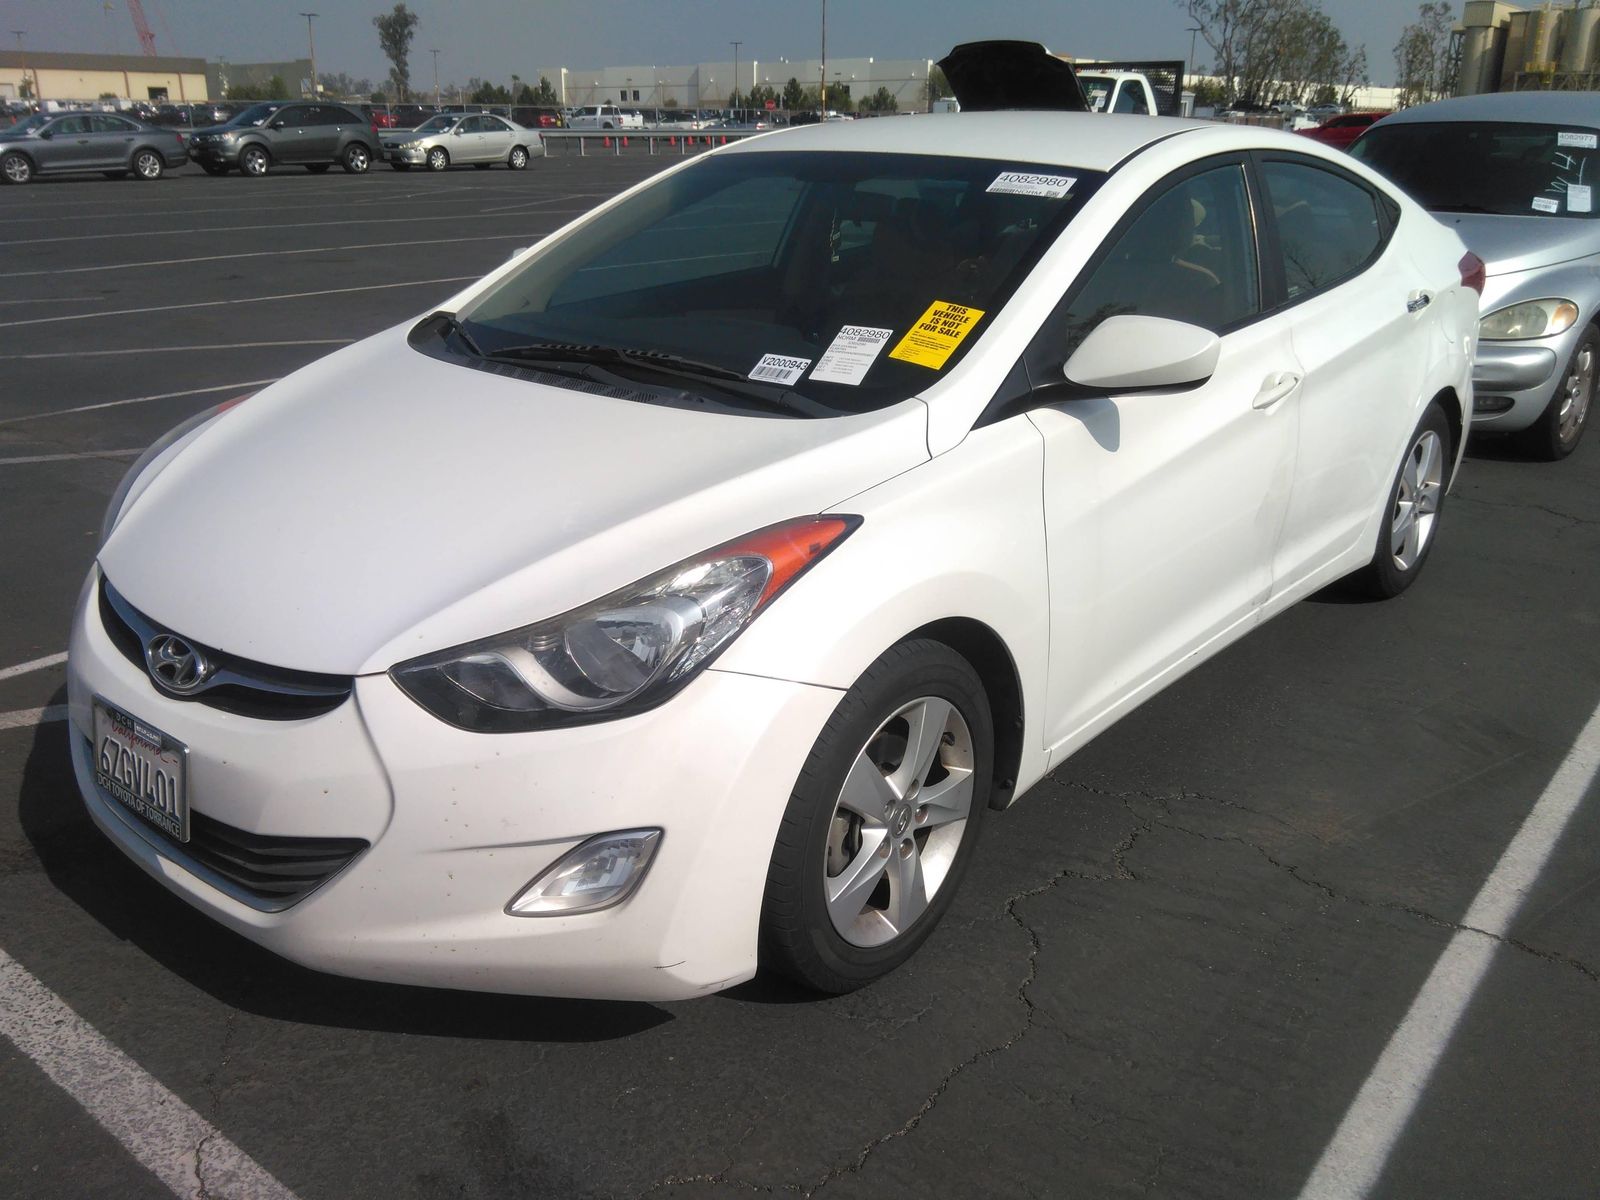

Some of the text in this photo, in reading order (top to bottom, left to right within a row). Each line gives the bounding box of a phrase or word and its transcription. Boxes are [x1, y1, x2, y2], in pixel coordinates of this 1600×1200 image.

[1000, 174, 1068, 187] 4082980
[932, 309, 971, 324] VEHICLE
[946, 304, 968, 315] THIS
[919, 323, 962, 339] FOR SALE
[930, 317, 962, 330] IS NOT
[840, 327, 891, 340] 4082980
[761, 356, 809, 371] V2000943
[101, 735, 181, 821] 6ZGV401
[111, 784, 136, 808] TOYOTA
[136, 800, 146, 814] OF
[145, 806, 181, 838] TORRANCE
